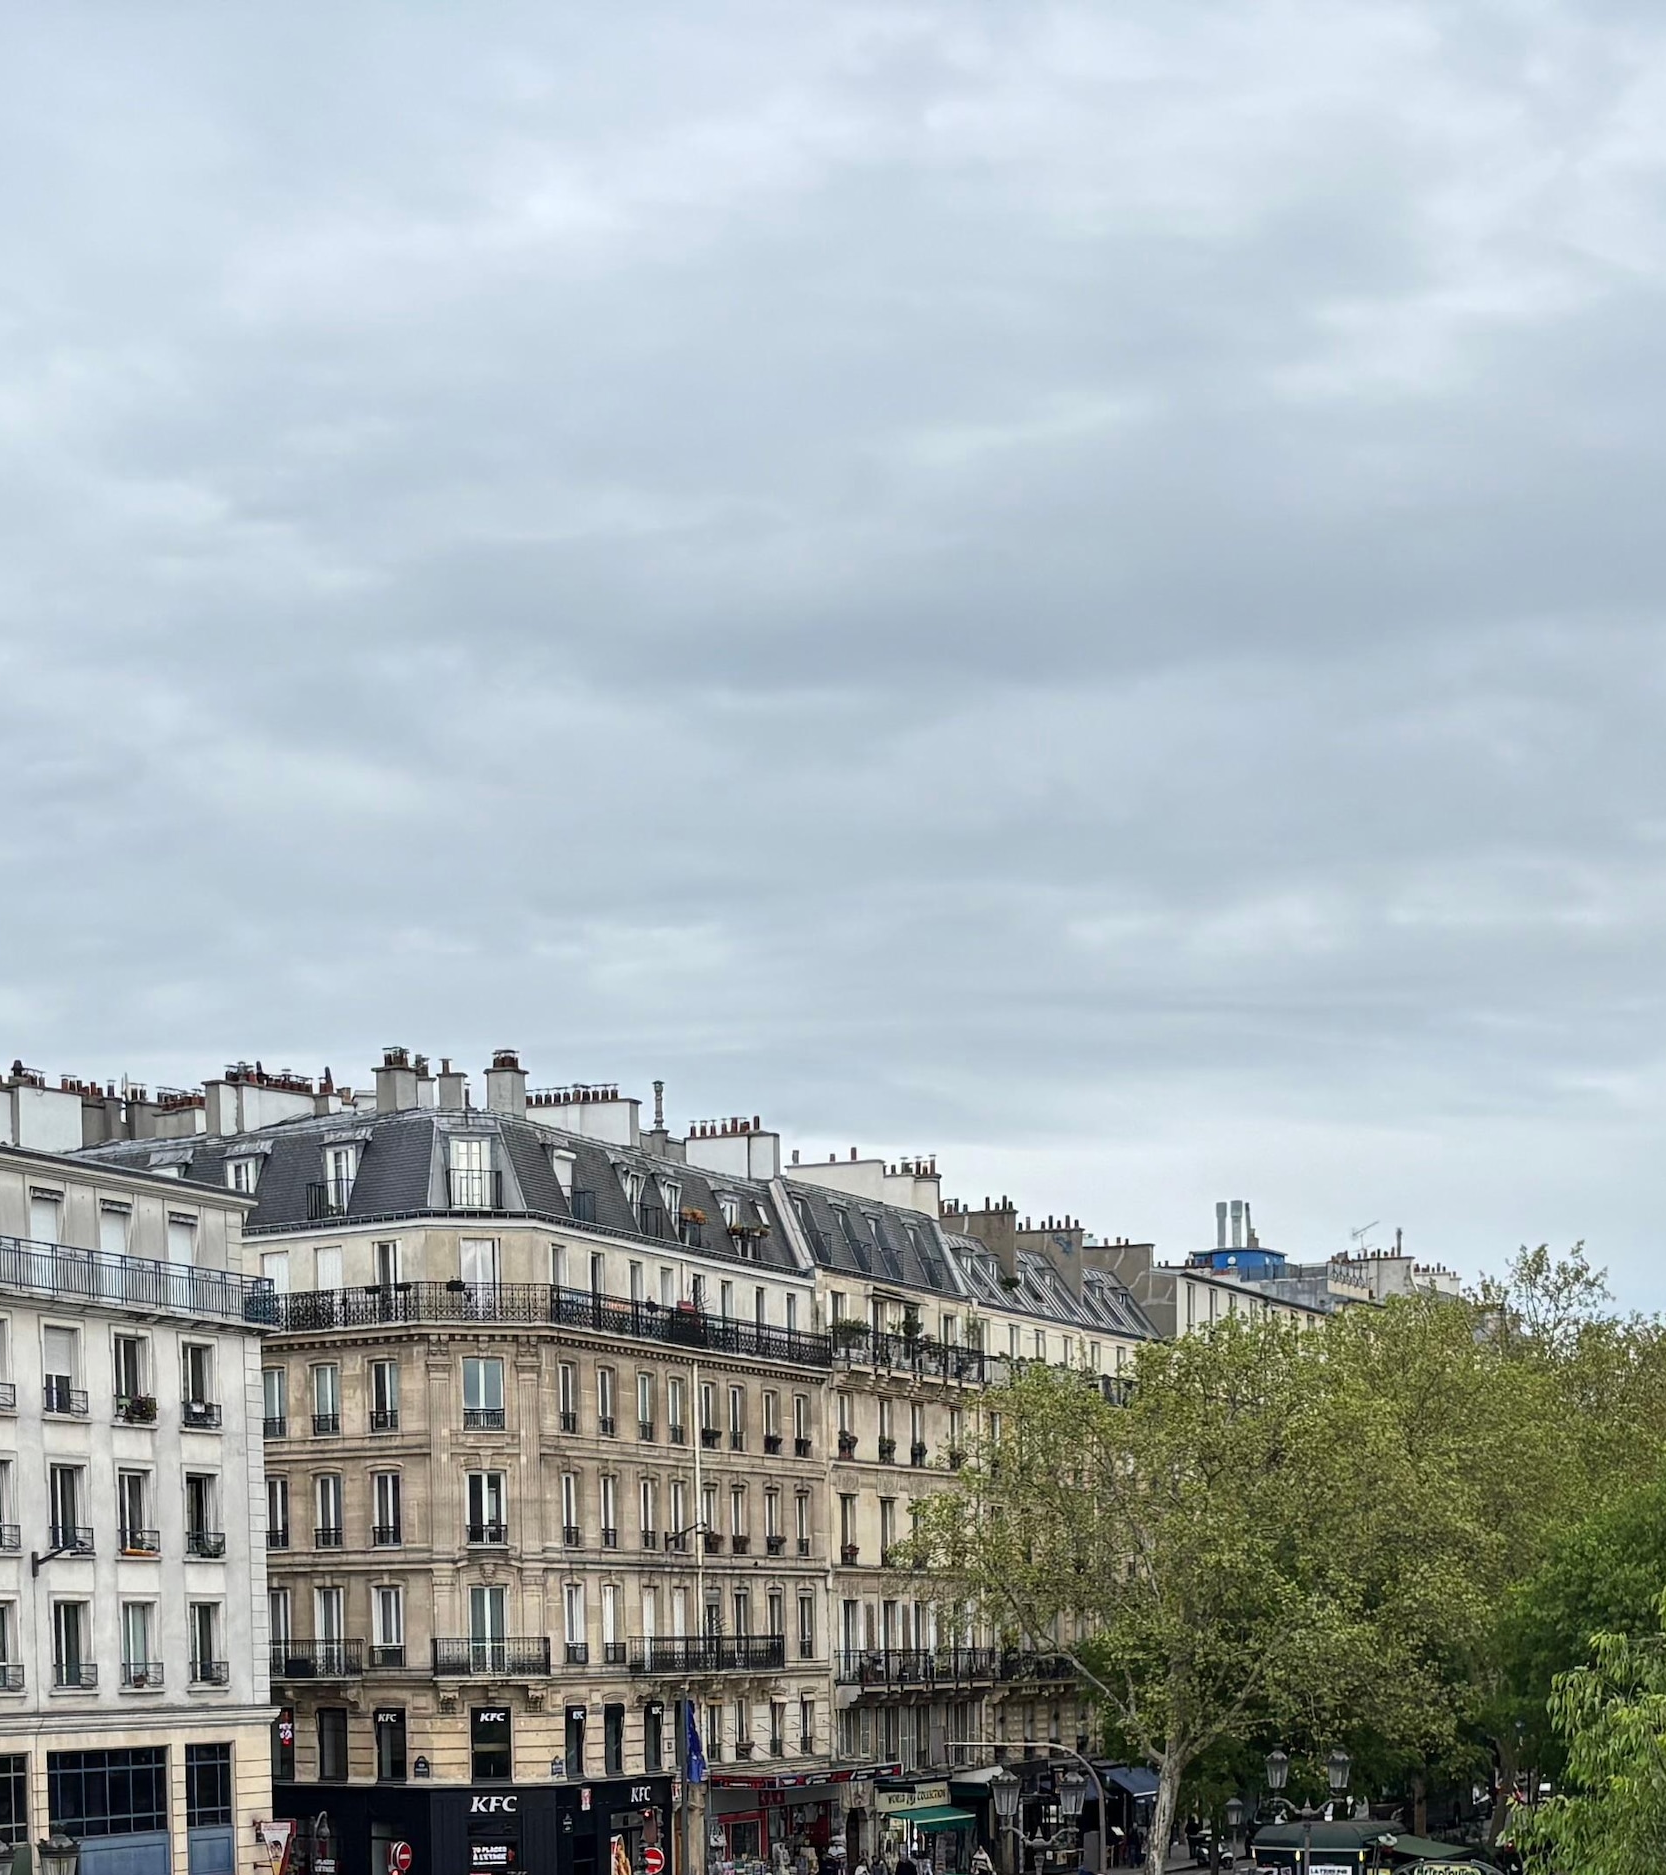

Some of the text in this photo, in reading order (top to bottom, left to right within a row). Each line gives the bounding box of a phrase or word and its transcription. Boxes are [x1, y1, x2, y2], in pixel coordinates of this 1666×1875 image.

[377, 1713, 397, 1723] KFC
[480, 1712, 506, 1722] KFC
[631, 1786, 652, 1803] KFC
[469, 1795, 518, 1813] KFC
